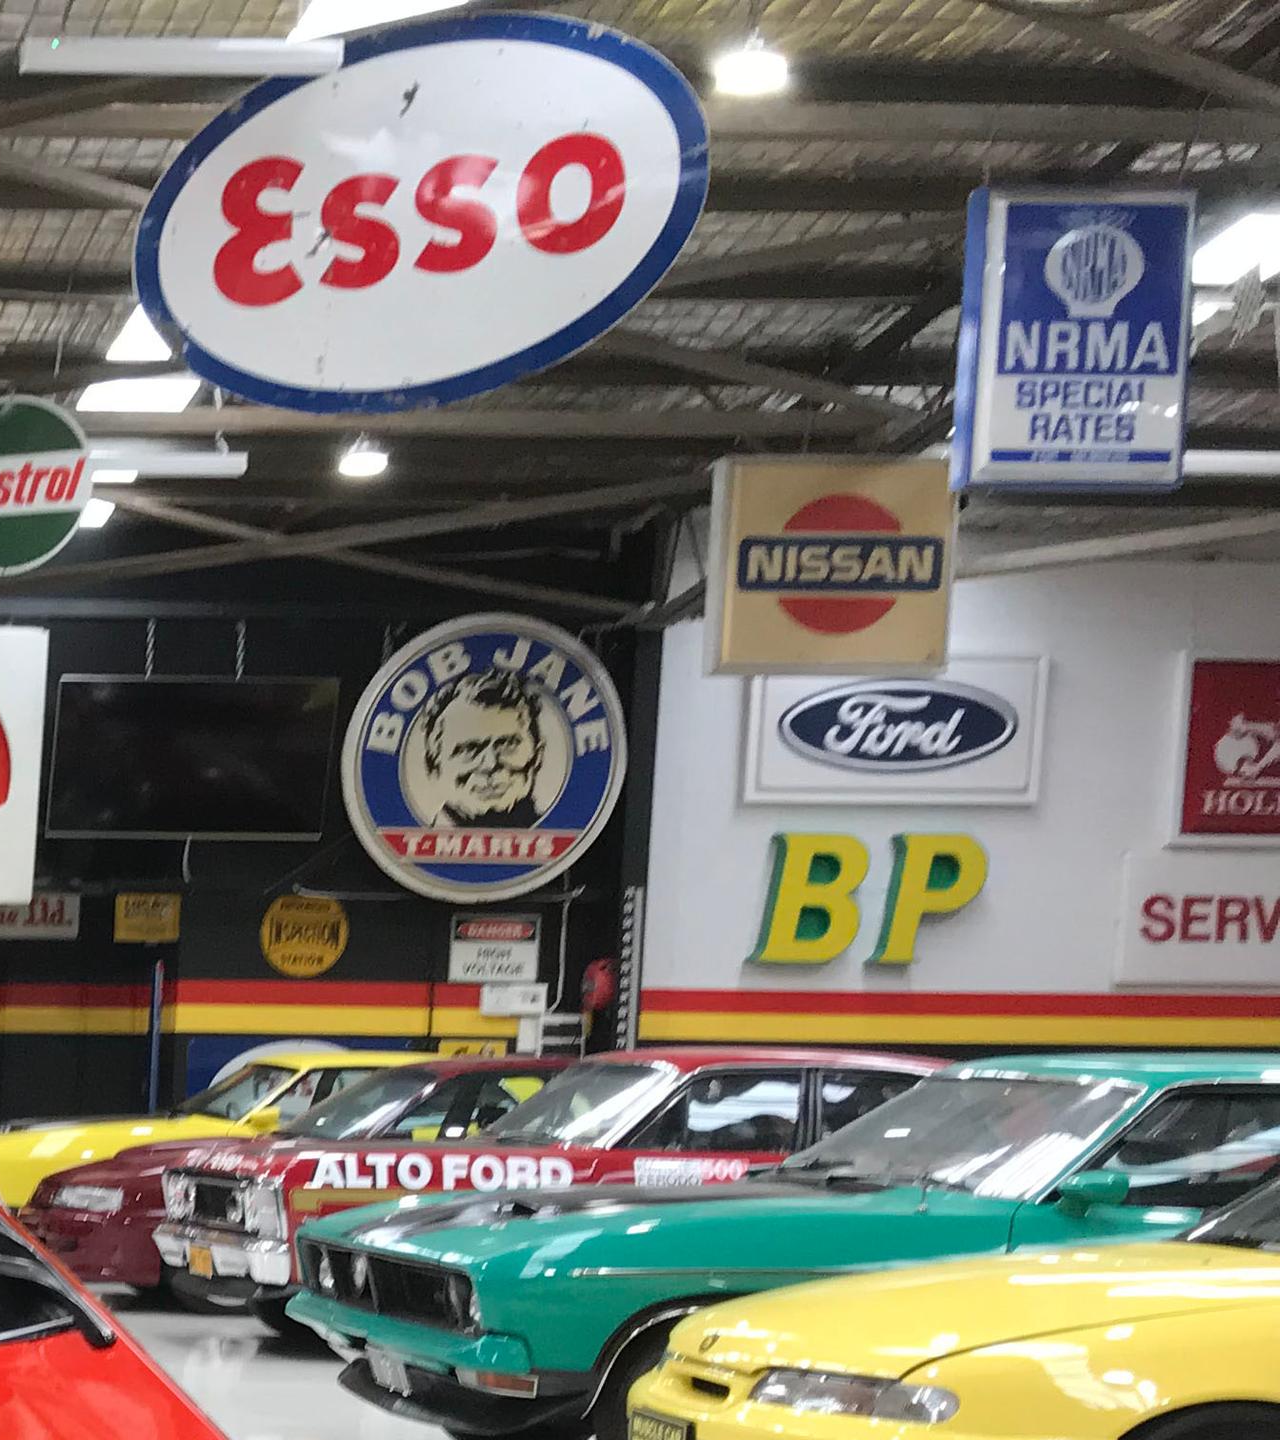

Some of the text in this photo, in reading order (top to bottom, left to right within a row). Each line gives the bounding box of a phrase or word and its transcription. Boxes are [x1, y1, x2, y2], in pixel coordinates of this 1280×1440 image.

[213, 131, 626, 308] ESSO
[1004, 320, 1171, 373] NRMA
[1017, 380, 1146, 410] SPECIAL
[1030, 412, 1135, 444] RATES
[746, 543, 937, 585] NISSAN
[367, 637, 610, 758] BOB JANE
[822, 694, 965, 757] Ford
[744, 833, 989, 965] BP
[467, 922, 523, 937] DANGER
[308, 1152, 574, 1191] ALTO FORD
